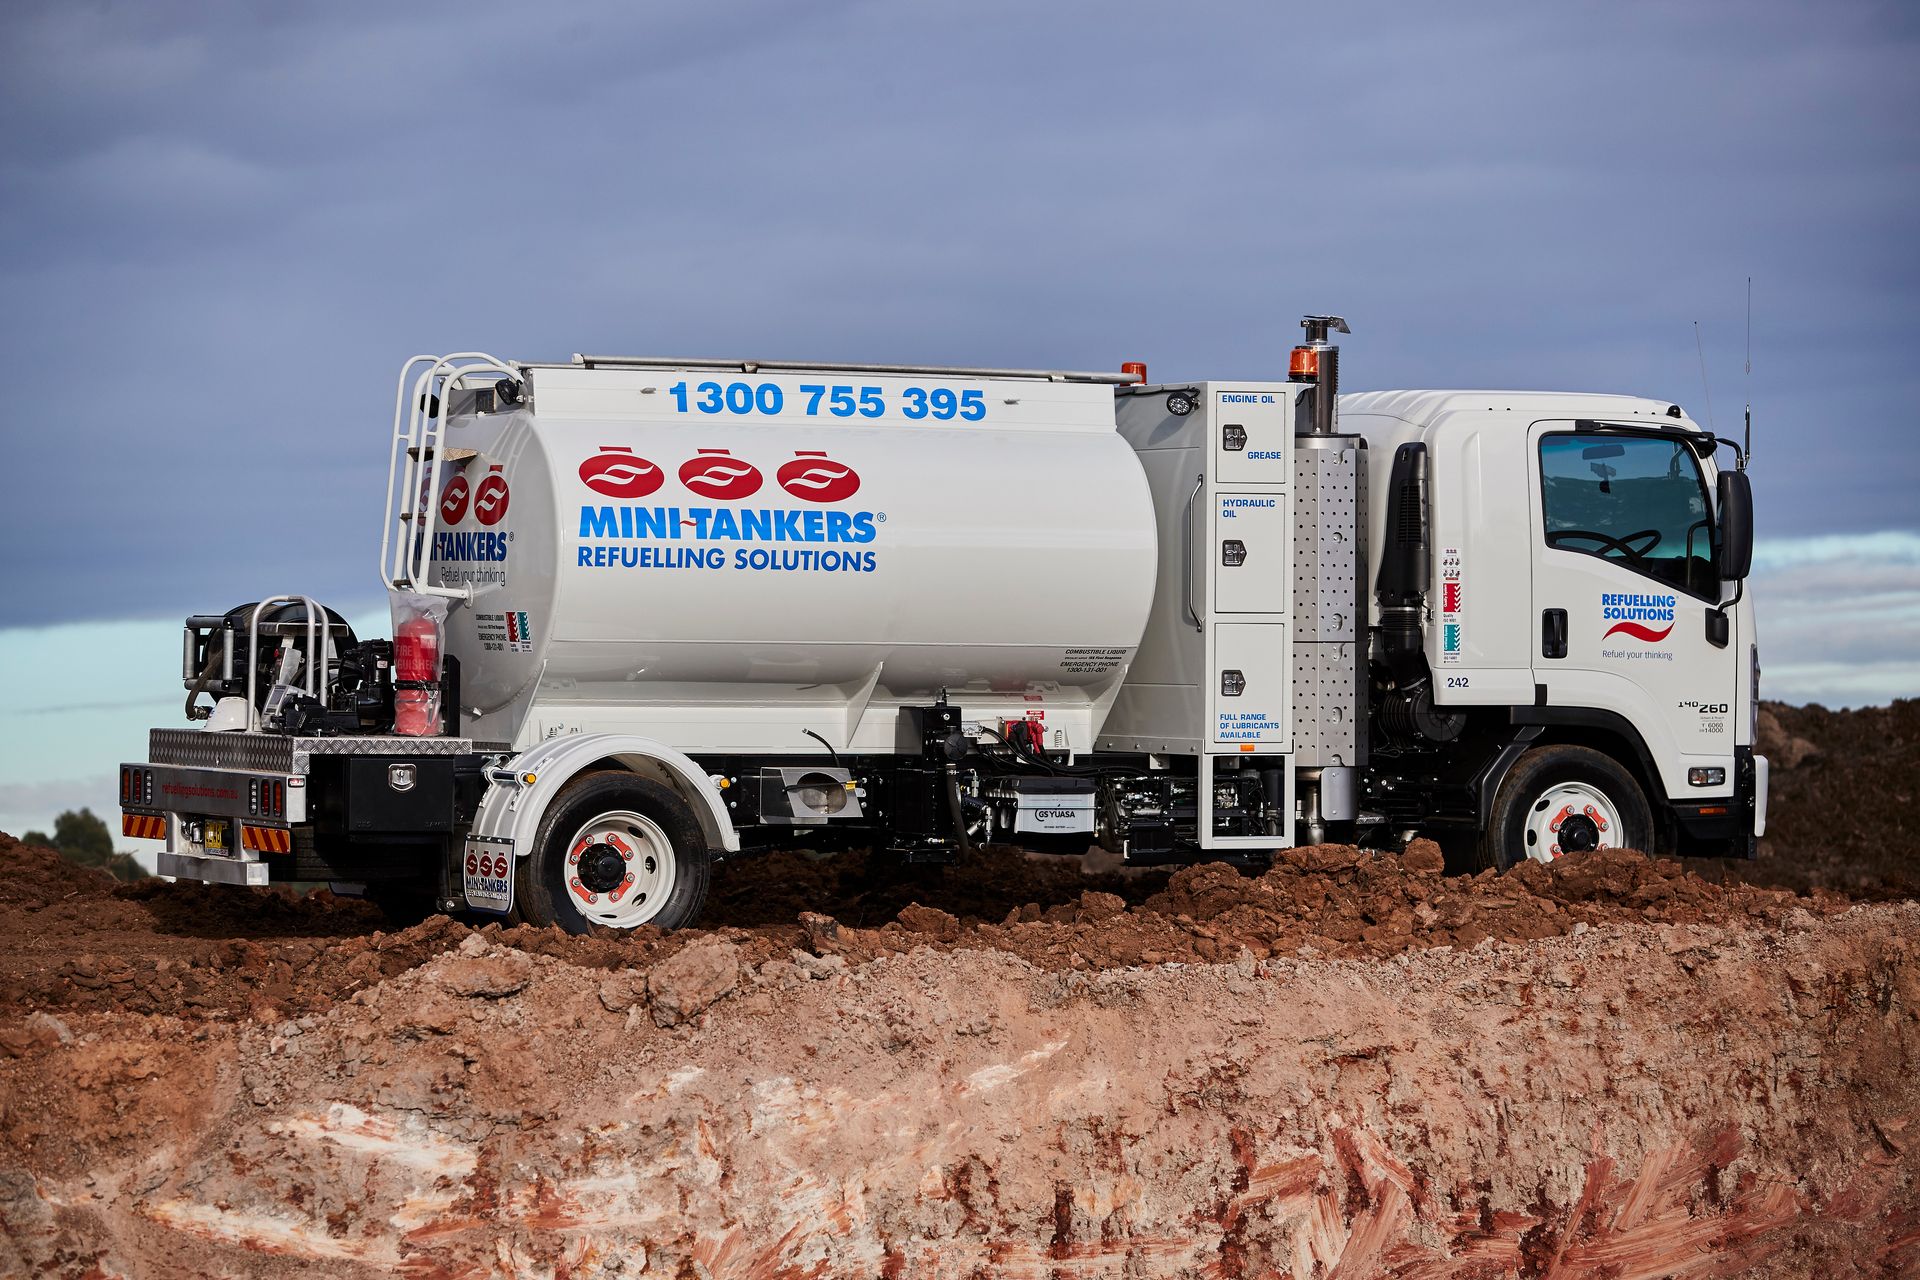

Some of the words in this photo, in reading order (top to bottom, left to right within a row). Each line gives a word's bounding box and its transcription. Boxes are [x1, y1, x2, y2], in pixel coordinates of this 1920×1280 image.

[669, 380, 785, 416] 1300
[799, 384, 887, 419] 755
[901, 387, 987, 423] 395
[1222, 395, 1258, 404] ENGINE
[1260, 395, 1276, 404] OIL
[1247, 451, 1282, 460] GREASE
[1222, 499, 1275, 508] HYDRAULIC
[1222, 509, 1237, 518] OIL
[577, 545, 727, 571] REFUELLING
[735, 548, 877, 573] SOLUTIONS
[441, 566, 460, 583] Refuel
[461, 571, 475, 586] your
[476, 566, 506, 587] thinking
[1601, 593, 1677, 608] REFUELLING
[1603, 607, 1675, 621] SOLUTIONS
[1602, 650, 1626, 659] Refuel
[1626, 652, 1643, 660] your
[1644, 651, 1673, 662] thinking
[1447, 677, 1470, 688] 242
[1699, 703, 1729, 714] 260
[1231, 722, 1280, 730] LUBRICANTS
[1220, 731, 1261, 739] AVAILABLE
[161, 783, 240, 800] refuellingsolutions.com.au
[1038, 810, 1049, 818] GS
[1049, 810, 1076, 818] YUASA
